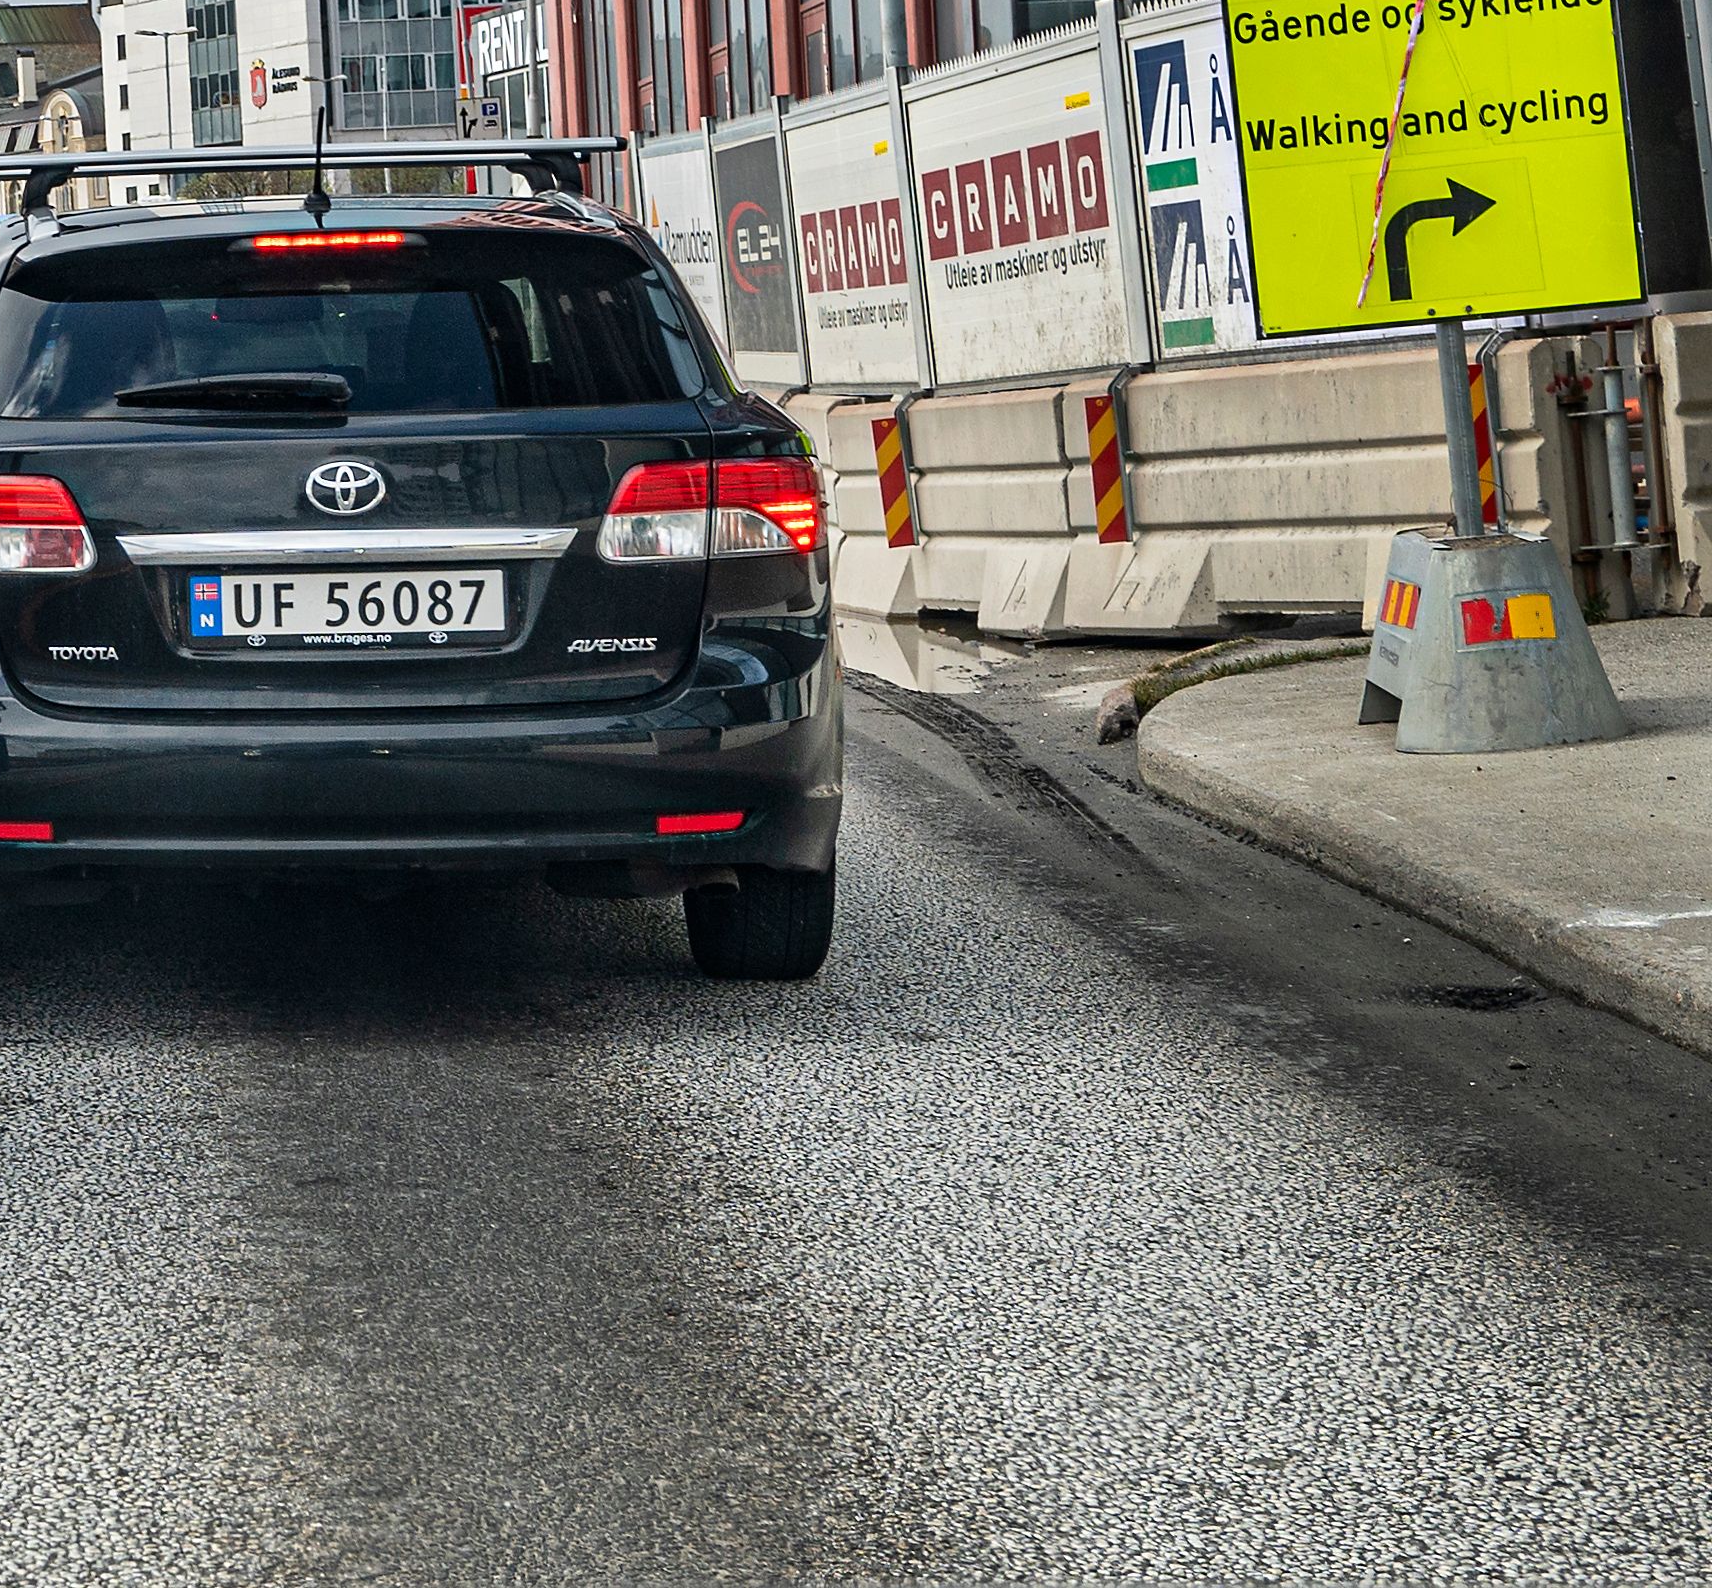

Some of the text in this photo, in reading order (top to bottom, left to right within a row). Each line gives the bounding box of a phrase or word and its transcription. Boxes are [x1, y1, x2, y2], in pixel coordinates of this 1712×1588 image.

[1233, 2, 1371, 44] Gående
[1382, 2, 1425, 35] og
[1245, 89, 1610, 153] Walking and cycling
[930, 154, 1098, 240] CRAMO
[805, 217, 902, 276] CRAMO
[944, 235, 1107, 290] Utleie av maskiner og utstyr
[200, 613, 215, 628] N
[232, 579, 486, 629] UF 56087
[48, 646, 119, 660] TOYOTA
[302, 632, 393, 645] www.brages.no
[566, 637, 658, 653] AVENSIS
